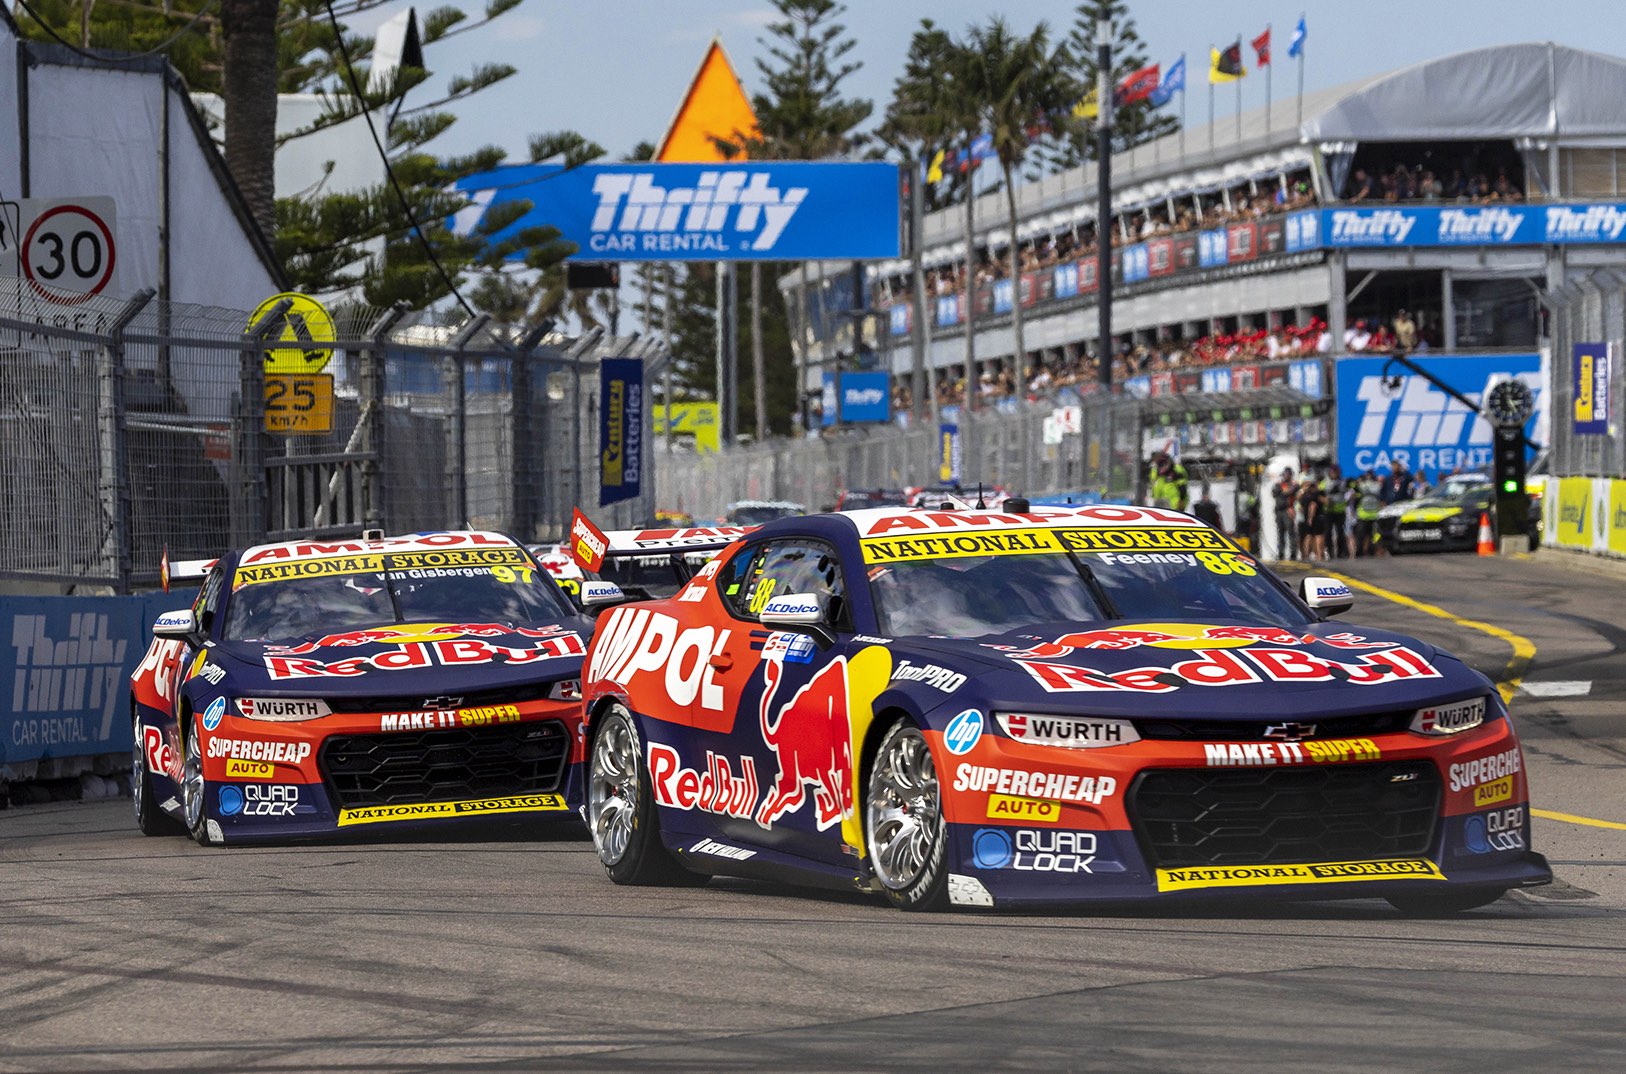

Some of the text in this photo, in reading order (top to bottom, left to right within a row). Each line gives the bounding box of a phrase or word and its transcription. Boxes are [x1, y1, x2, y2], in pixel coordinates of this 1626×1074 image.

[591, 172, 808, 250] Thrifty
[1438, 208, 1525, 241] Thrifty
[1331, 210, 1417, 242] Thrifty
[35, 231, 102, 280] 30
[590, 234, 726, 251] CAR RENTAL
[265, 380, 316, 411] 25
[270, 415, 308, 426] km/h
[624, 383, 641, 484] Batteries
[1354, 449, 1493, 471] CAR RENT
[866, 506, 1197, 536] AMPOL
[866, 530, 1222, 560] NATIONAL STORAGE
[240, 550, 524, 582] NATIONAL STORAGE
[1097, 552, 1197, 567] Feeney
[408, 567, 492, 581] Gisbergen
[490, 565, 535, 584] 97
[587, 586, 621, 596] ACDelc
[749, 577, 777, 613] 88
[1316, 585, 1349, 596] ACDelc
[764, 603, 819, 613] ACDelco
[263, 634, 588, 681] Red Bull
[587, 607, 732, 712] AMPOL
[1010, 645, 1445, 694] Red Bull
[11, 612, 128, 741] Thrifty
[890, 660, 968, 694] ToolPRO
[206, 702, 222, 725] hp
[380, 704, 521, 732] MAKE IT SUPER
[12, 717, 88, 746] CAR RENTAL
[948, 716, 979, 752] hp
[207, 736, 311, 764] SUPERCHEAP
[1204, 739, 1382, 766] MAKE IT SUPER
[231, 762, 269, 774] AUTO
[648, 741, 760, 819] Red Bull
[244, 784, 299, 804] QUAD
[953, 762, 1117, 804] SUPERCHEAP
[1478, 781, 1509, 801] AUTO
[242, 801, 297, 816] LOCK
[346, 796, 556, 820] NATIONAL STORAGE
[994, 800, 1052, 816] AUTO
[1487, 807, 1523, 833] QUAD
[1015, 830, 1097, 854] QUAD
[1013, 852, 1096, 874] LOCK
[1168, 860, 1428, 883] NATIONAL STORAGE
